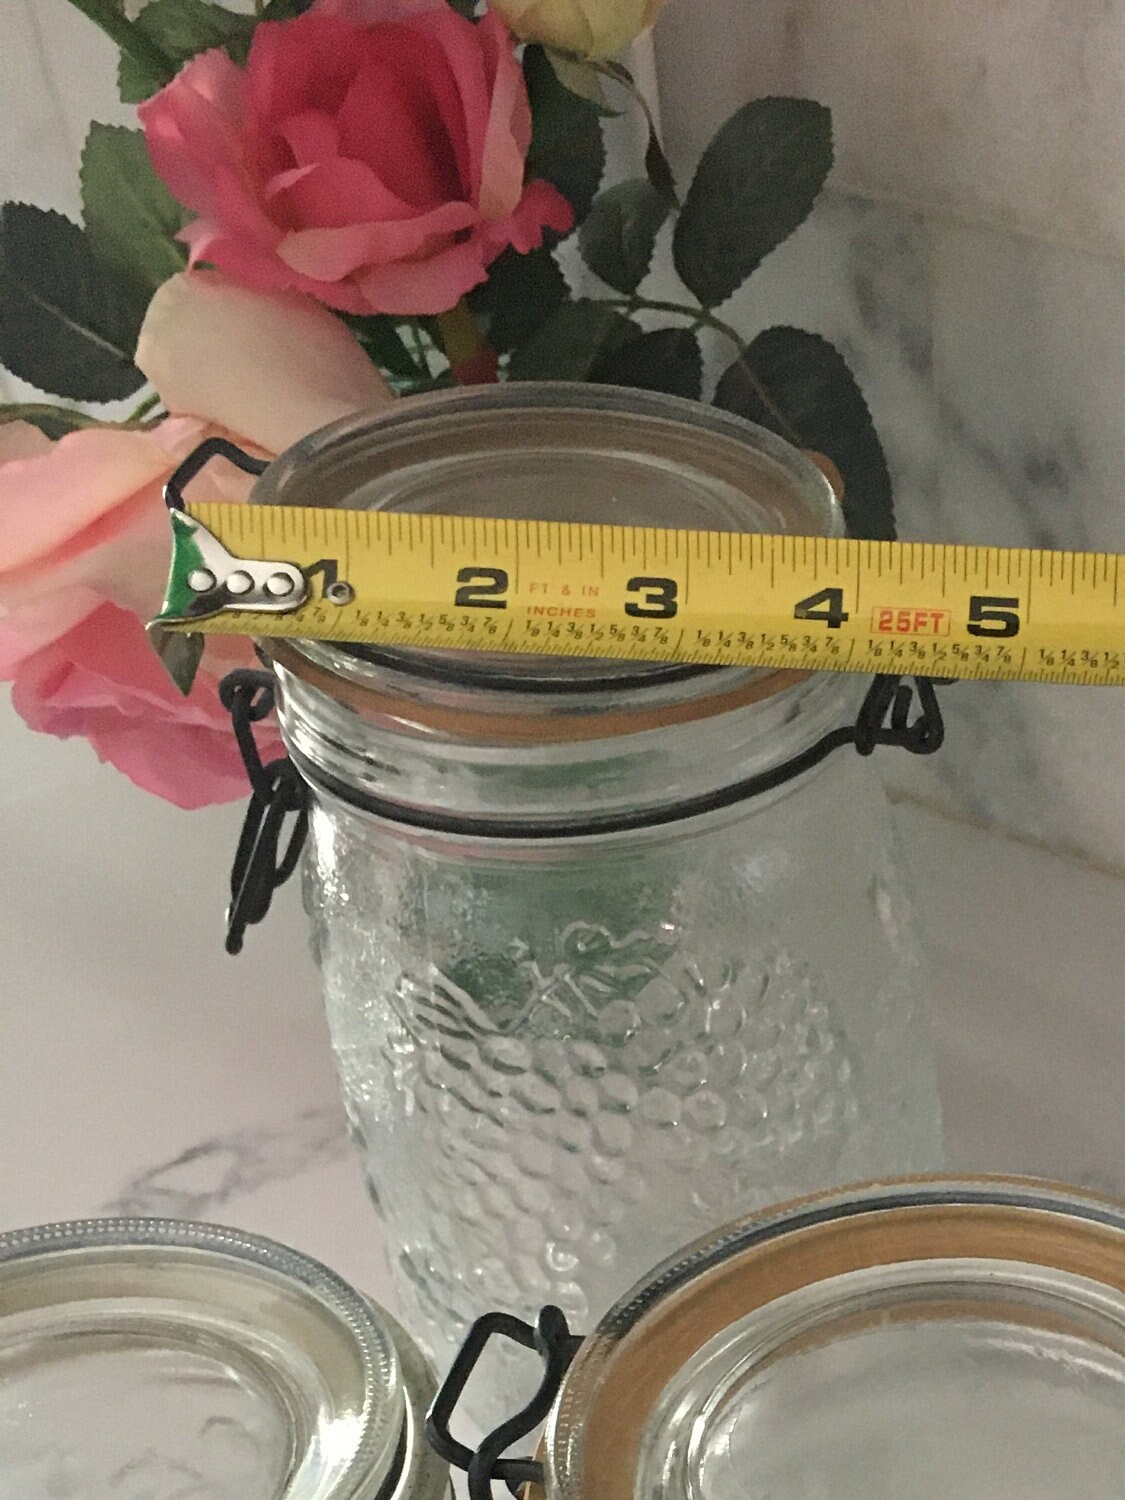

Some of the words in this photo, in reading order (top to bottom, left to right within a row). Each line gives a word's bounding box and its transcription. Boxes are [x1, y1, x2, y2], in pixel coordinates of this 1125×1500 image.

[304, 559, 338, 599] 1
[454, 567, 508, 609] 2
[625, 576, 679, 619] 3
[793, 588, 849, 629] 4
[966, 595, 1020, 639] 5
[529, 583, 553, 596] FT
[561, 584, 572, 597] &
[580, 585, 599, 598] IN
[526, 605, 596, 619] INCHES
[878, 610, 944, 635] 25FT
